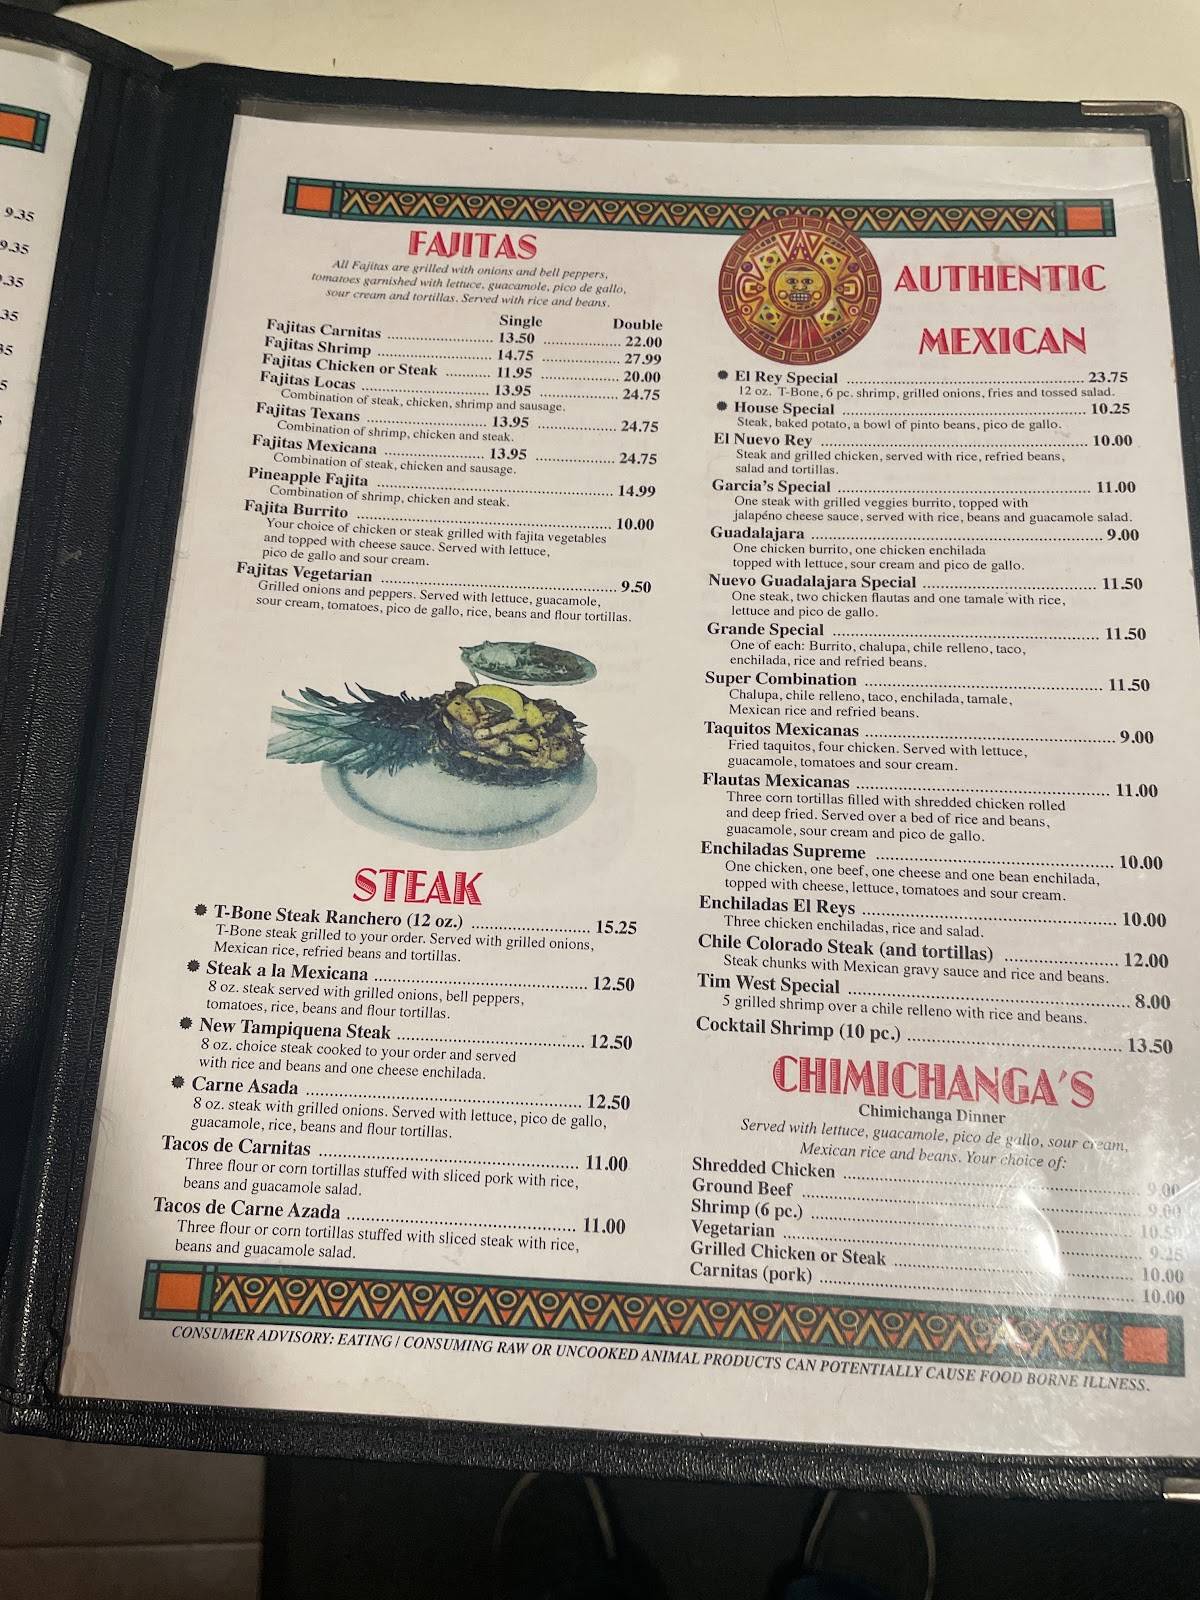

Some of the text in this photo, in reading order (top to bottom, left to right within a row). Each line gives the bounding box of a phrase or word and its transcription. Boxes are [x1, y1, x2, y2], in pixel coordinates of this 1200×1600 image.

[4, 207, 35, 222] 9.35
[0, 240, 30, 255] 9.35
[408, 230, 537, 260] FAJITAS
[332, 259, 608, 280] All Fajitas are grilled with onions and bell peppers,
[894, 264, 1106, 292] AUTHENTIC
[267, 318, 662, 348] Fajitas Carnitas 13.50 22.00
[499, 314, 663, 331] Single Double
[918, 327, 1086, 355] MEXICAN
[262, 353, 661, 383] Fajitas Chicken or Steak 11.95 20.00
[735, 370, 1128, 386] El Rey Special 23.75
[260, 370, 660, 401] Fajitas Locas 13.95 24.75
[740, 385, 1115, 401] 12 oz. T-Bone, 6 pc. shrimp, grilled onions, fries and tossed salad.
[281, 388, 565, 414] Combination of steak, chicken, shrimp and sausage.
[249, 466, 656, 498] Pineapple Fajita 14.99
[244, 499, 654, 531] Fajita Burrito 10.00
[710, 526, 1139, 542] Guadalajara 9.00
[733, 542, 986, 556] One chicken burrito, one chicken enchilada
[236, 561, 652, 593] Fajitas Vegetarian 9.50
[256, 597, 631, 622] sour cream, tomatoes, pico de gallo, rice, beans and flour tortillas.
[705, 671, 1150, 692] Super Combination 11.50
[703, 772, 1158, 798] Flautas Mexicanas 11.00
[352, 868, 483, 906] STEAK
[214, 904, 637, 935] T-Bone Steak Ranchero (12 oz.) 15.25
[214, 941, 461, 962] Mexican rice, refried beans and tortillas.
[698, 933, 1169, 969] Chile Colorado Steak (and tortillas) 12.00
[199, 1017, 633, 1050] New Tampiquena Steak 12.50
[696, 1015, 1173, 1054] Cocktail Shrimp (10 pc.) 13.50
[192, 1076, 630, 1111] Carne Asada 12.50
[772, 1055, 1094, 1108] CHIMICHANGA'S
[858, 1103, 1006, 1124] Chimichanga Dinner
[692, 1156, 1181, 1198] Shredded Chicken 9.00
[153, 1196, 626, 1235] Tacos de Carne Azada 11.00
[690, 1240, 1185, 1284] Grilled Chicken or Steak 10.00
[690, 1261, 1185, 1306] Carnitas (pork) 10.00
[172, 1325, 256, 1343] CONSUMER
[257, 1328, 334, 1345] ADVISORY:
[337, 1333, 393, 1348] EATING
[403, 1336, 493, 1353] CONSUMING
[496, 1341, 529, 1355] RAW
[531, 1343, 552, 1356] OR
[556, 1344, 639, 1361] UNCOOKED
[641, 1349, 700, 1365] ANIMAL
[703, 1353, 782, 1369] PRODUCTS
[786, 1358, 817, 1371] CAN
[820, 1360, 923, 1378] POTENTIALLY
[926, 1367, 976, 1381] CAUSE
[980, 1370, 1022, 1383] FOOD
[1027, 1372, 1078, 1387] BORNE
[1083, 1376, 1150, 1391] ILLNESS.
